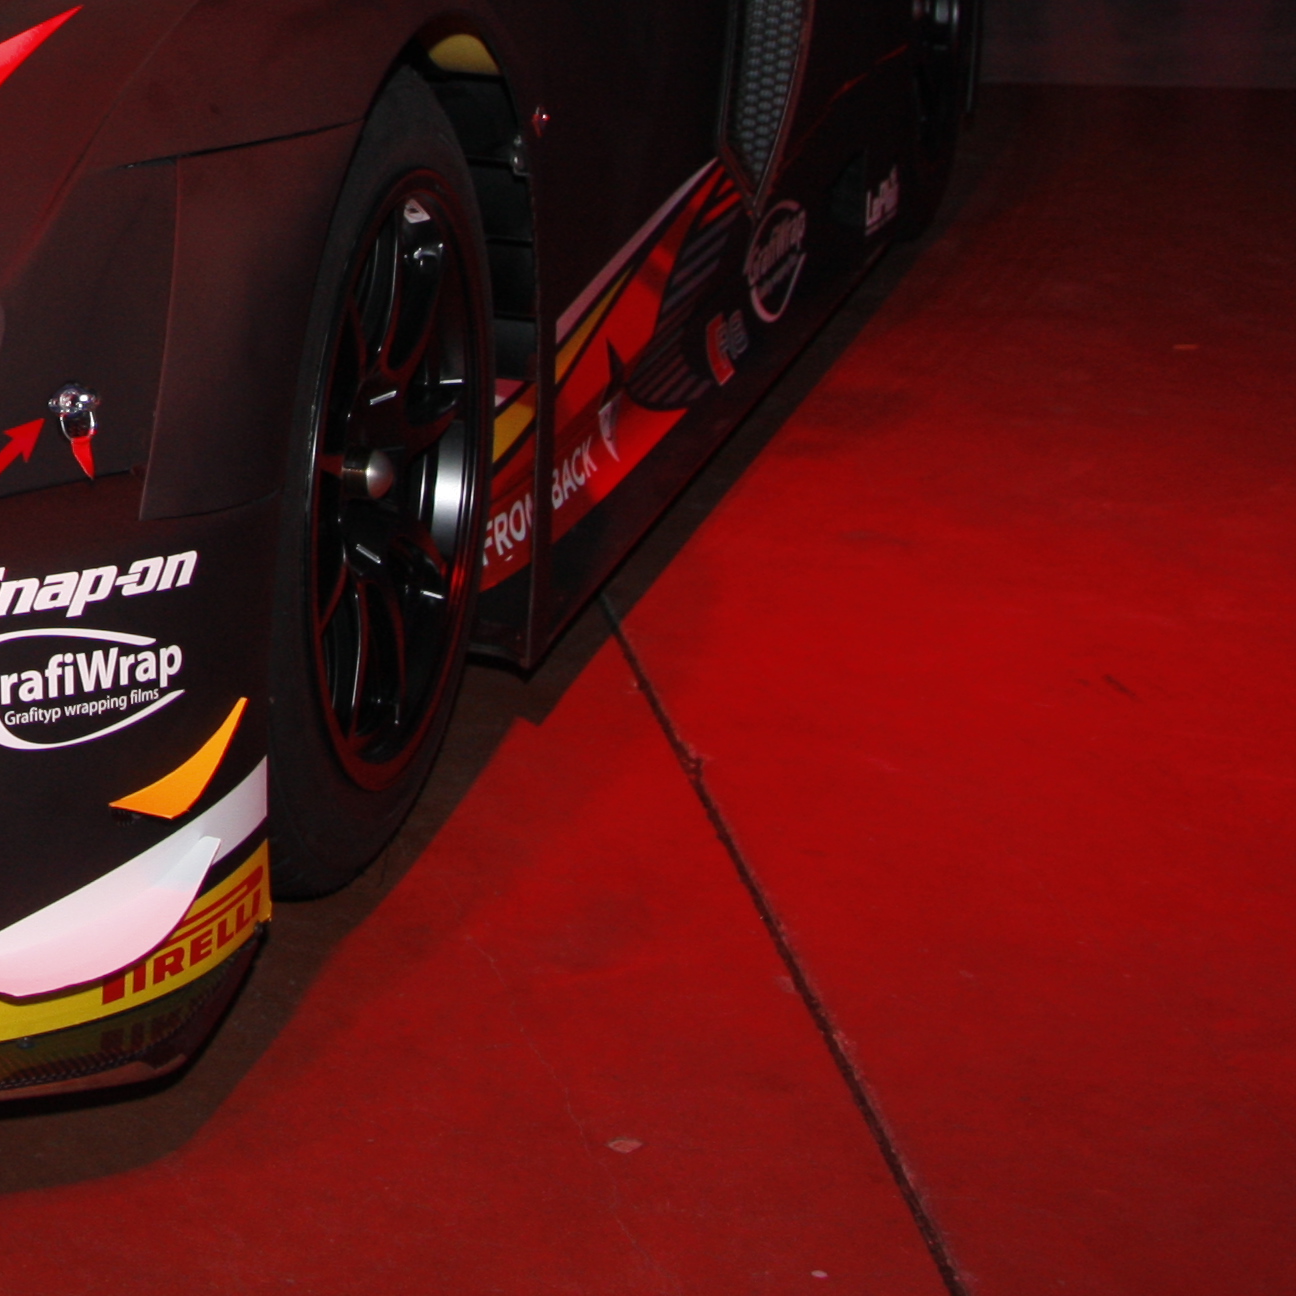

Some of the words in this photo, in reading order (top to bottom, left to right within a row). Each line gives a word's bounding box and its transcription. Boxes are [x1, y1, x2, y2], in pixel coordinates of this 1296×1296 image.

[4, 704, 61, 727] Grafityp
[64, 694, 127, 722] wrapping
[130, 688, 159, 709] films
